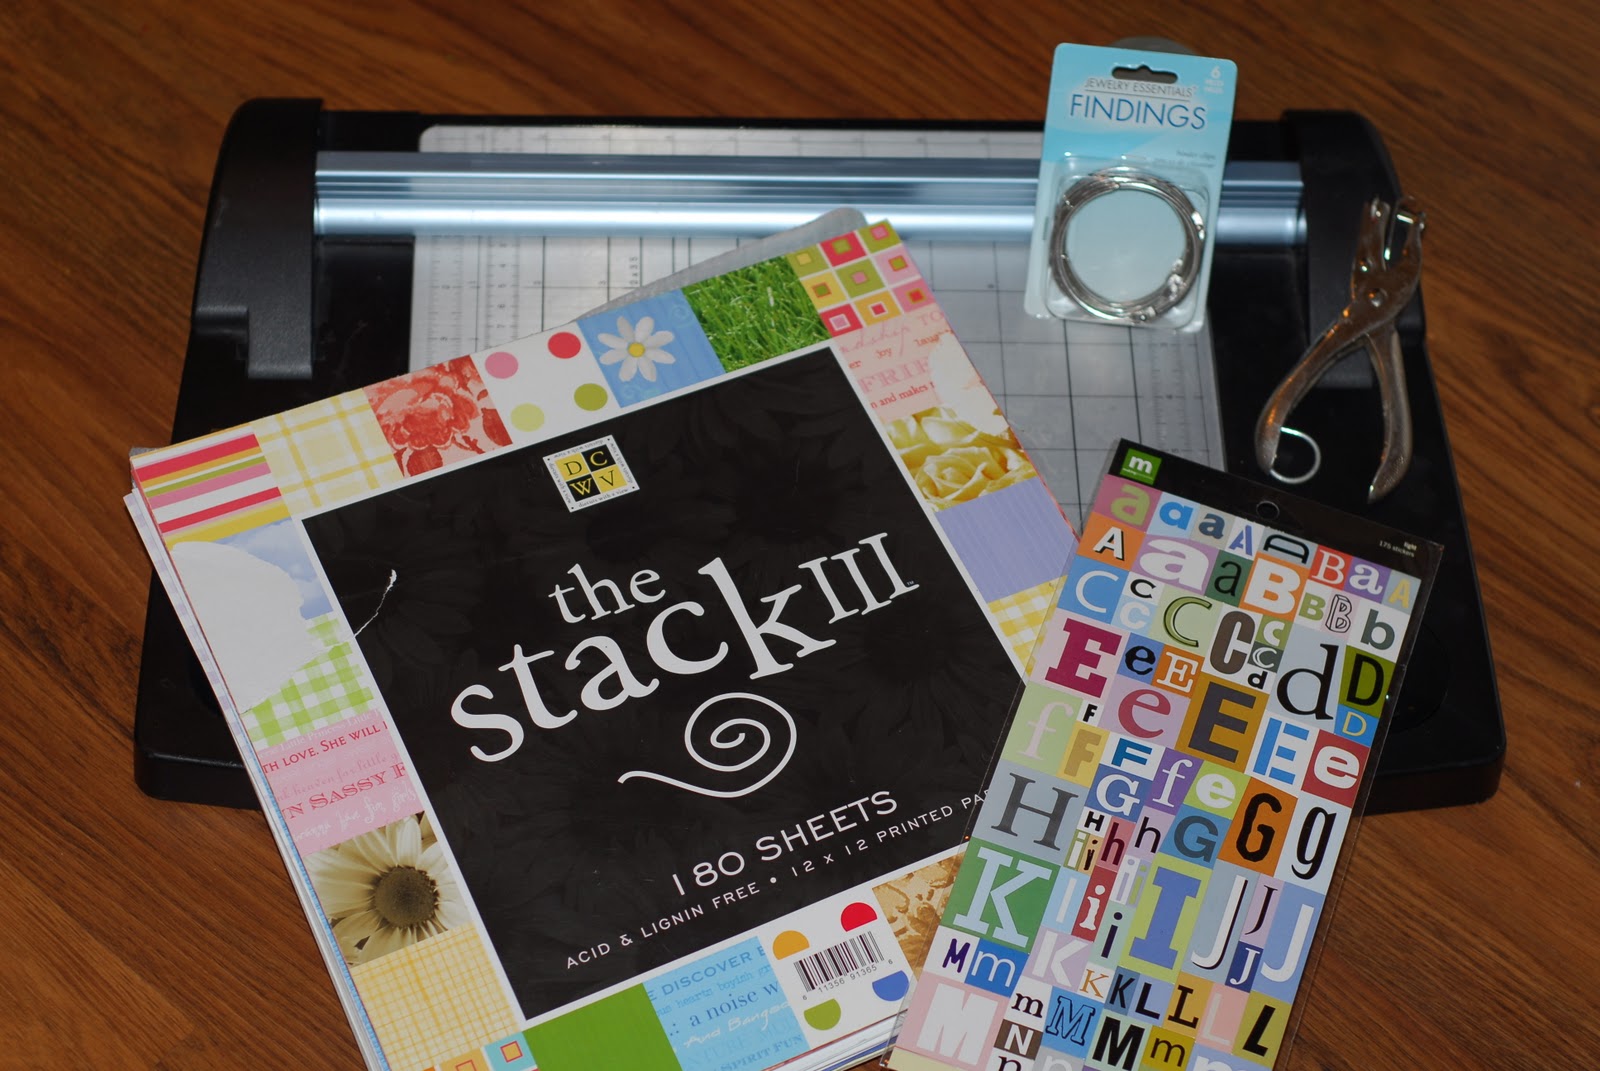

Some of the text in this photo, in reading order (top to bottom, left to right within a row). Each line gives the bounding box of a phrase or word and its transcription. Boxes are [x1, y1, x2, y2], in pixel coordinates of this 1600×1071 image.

[1084, 77, 1129, 93] JEWELRY
[1070, 94, 1206, 130] FINDINGS
[879, 392, 897, 406] and
[899, 383, 929, 399] makes
[564, 451, 608, 475] D C
[569, 477, 593, 495] W
[599, 470, 614, 486] V
[1128, 455, 1153, 475] m
[1111, 484, 1150, 526] a
[1199, 513, 1225, 539] a
[1092, 526, 1125, 561] A
[1229, 524, 1253, 556] A
[1139, 539, 1210, 591] a
[1214, 560, 1242, 597] a
[1244, 557, 1301, 614] B
[1311, 549, 1345, 585] B
[1349, 564, 1384, 595] a
[548, 563, 666, 624] the
[1299, 592, 1326, 621] B
[1325, 594, 1352, 633] B
[1388, 579, 1411, 609] A
[450, 532, 919, 763] stack III
[1360, 609, 1395, 650] b
[1044, 617, 1123, 698] E
[1125, 645, 1156, 675] e
[1156, 651, 1199, 693] E
[1248, 670, 1268, 690] d
[1276, 643, 1339, 720] d
[1346, 653, 1384, 706] D
[1016, 701, 1074, 761] f
[1083, 703, 1098, 722] F
[1118, 689, 1171, 738] e
[1188, 681, 1256, 763] E
[1342, 711, 1367, 736] D
[282, 748, 319, 767] LOVE.
[348, 725, 381, 740] WILL
[1063, 728, 1102, 777] F
[1111, 737, 1153, 767] F
[1253, 717, 1310, 785] E
[1152, 759, 1193, 808] f
[1313, 746, 1360, 789] e
[991, 772, 1078, 851] H
[1096, 774, 1140, 816] G
[1195, 773, 1236, 809] e
[1084, 811, 1105, 832] H
[1134, 816, 1161, 854] h
[1174, 817, 1218, 862] G
[1236, 793, 1282, 862] G
[672, 791, 898, 896] 180 SHEETS
[1101, 821, 1125, 866] h
[1291, 806, 1337, 880] g
[566, 941, 610, 969] ACID
[620, 933, 634, 946] &
[640, 904, 704, 938] LIGNIN
[712, 881, 761, 909] FREE
[791, 860, 815, 877] 12
[845, 839, 868, 855] 12
[876, 805, 953, 843] PRINTED
[953, 847, 1052, 948] K
[1079, 884, 1105, 931] i
[1129, 866, 1202, 970] I
[1190, 874, 1248, 970] J
[1245, 884, 1278, 935] J
[942, 938, 971, 974] M
[1101, 911, 1123, 959] i
[1260, 903, 1315, 982] J
[661, 951, 753, 996] DISCOVER
[818, 977, 845, 993] 11356
[850, 964, 877, 980] 91365
[971, 950, 1016, 988] m
[1032, 929, 1089, 988] K
[1229, 947, 1261, 985] J
[676, 988, 713, 1008] hearts
[1079, 968, 1109, 999] K
[1109, 973, 1135, 1009] K
[1135, 982, 1160, 1020] L
[689, 1014, 701, 1027] a
[706, 993, 759, 1021] noise
[916, 983, 999, 1066] M
[1011, 992, 1044, 1019] m
[1045, 995, 1096, 1046] M
[1167, 985, 1199, 1029] L
[1202, 992, 1232, 1047] L
[1004, 1023, 1034, 1055] N
[1092, 1016, 1145, 1071] M
[1242, 1004, 1276, 1057] L
[1150, 1037, 1185, 1068] m
